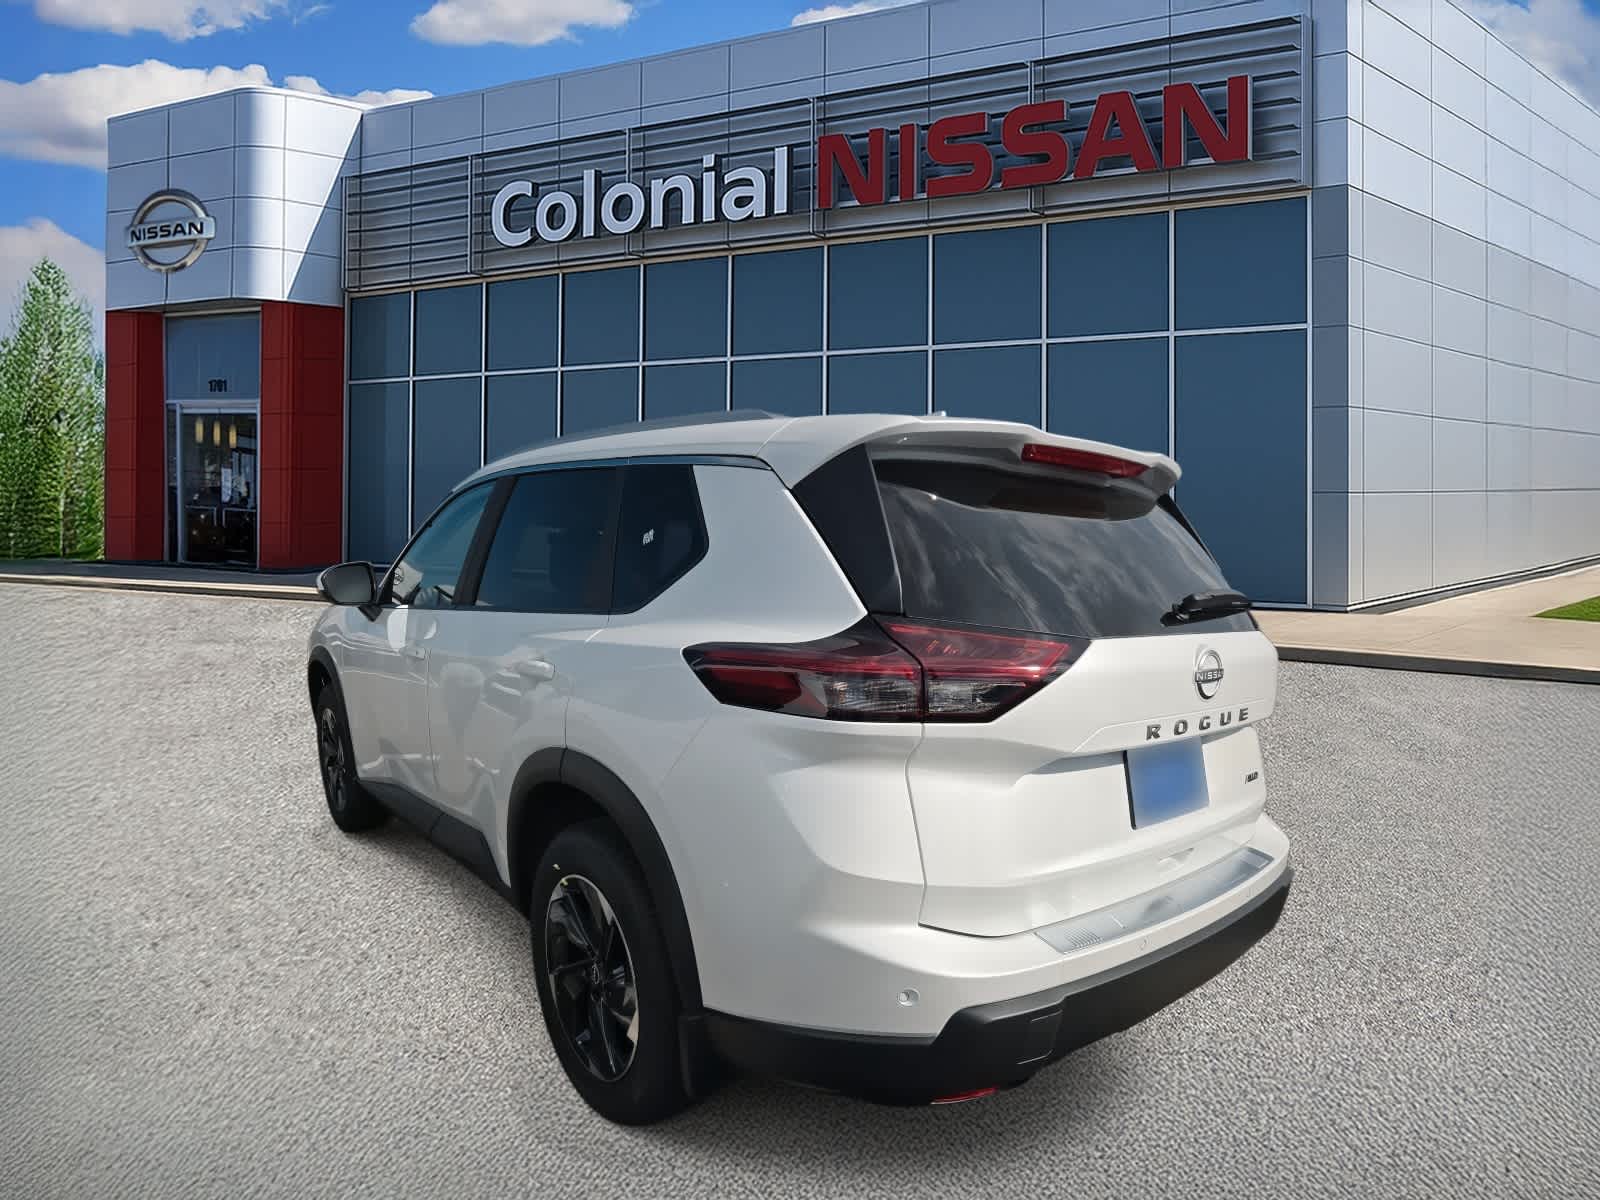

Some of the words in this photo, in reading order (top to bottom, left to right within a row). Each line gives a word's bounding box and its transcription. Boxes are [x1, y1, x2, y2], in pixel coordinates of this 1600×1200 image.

[491, 145, 792, 248] Colonial
[817, 74, 1253, 210] NISSAN
[130, 221, 204, 243] NISSAN
[1146, 708, 1249, 741] ROGUE
